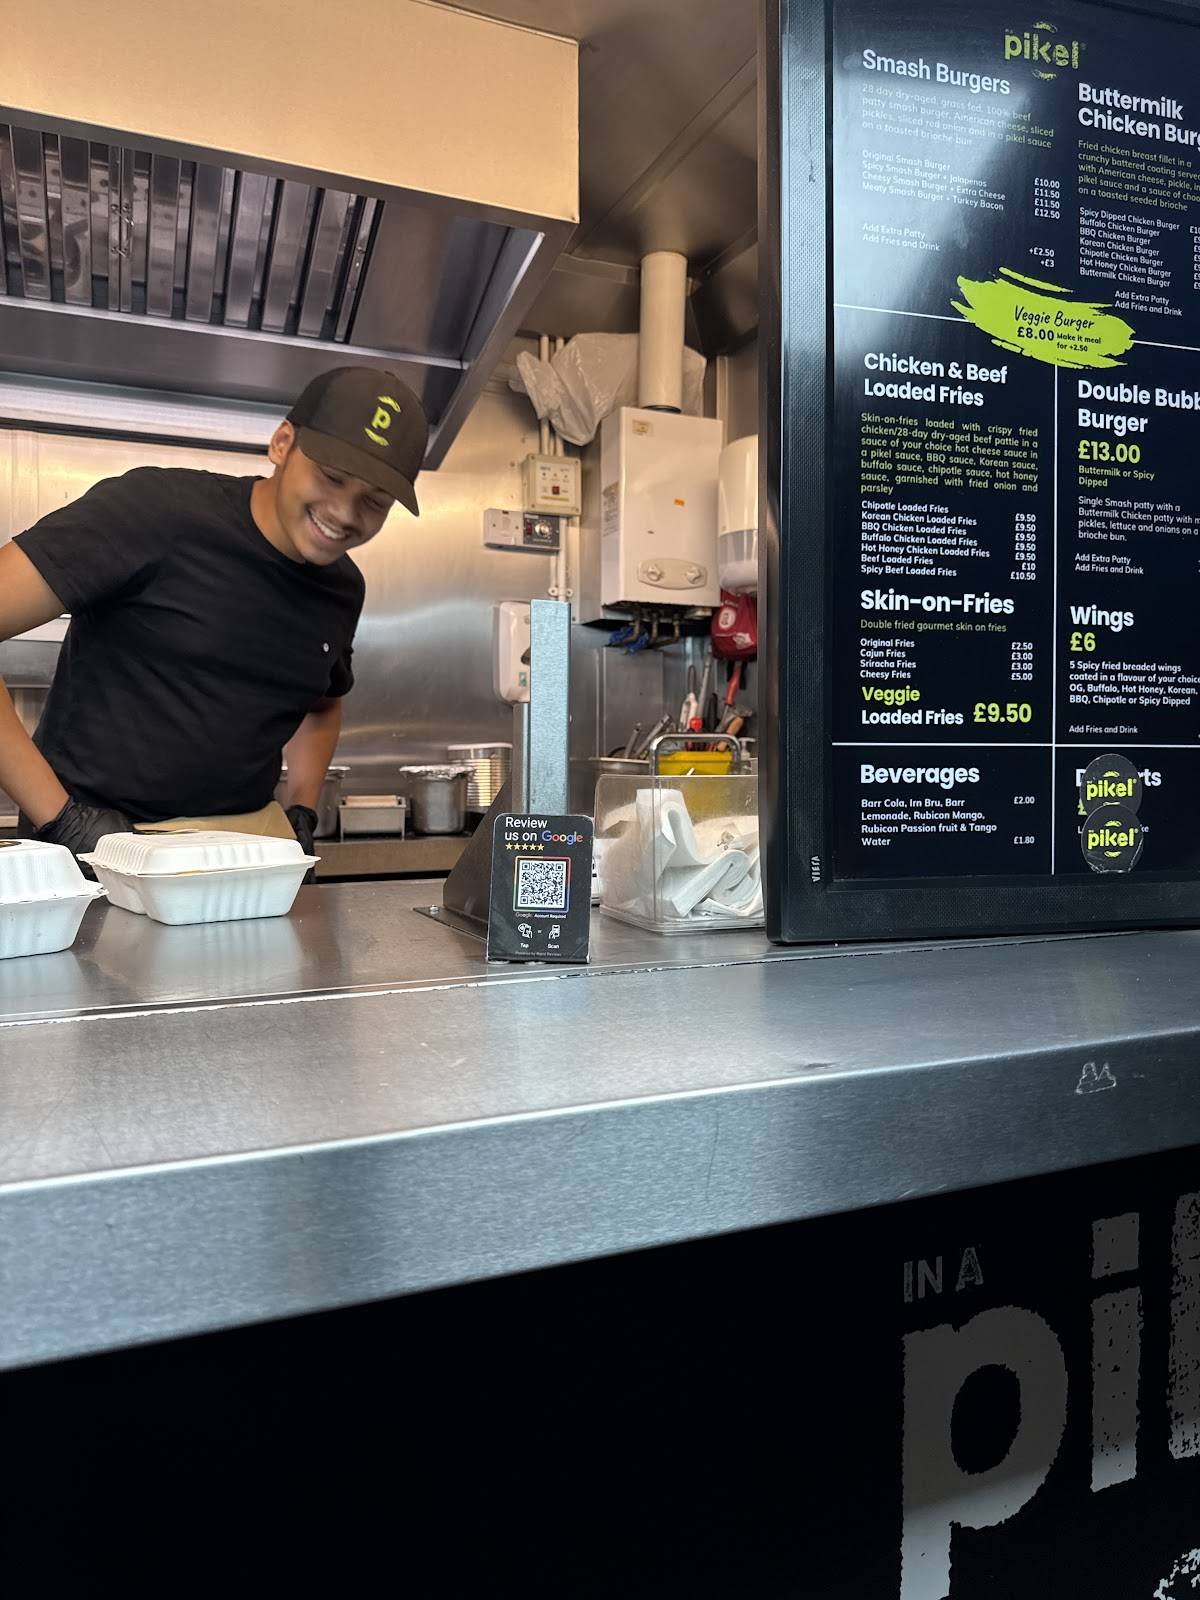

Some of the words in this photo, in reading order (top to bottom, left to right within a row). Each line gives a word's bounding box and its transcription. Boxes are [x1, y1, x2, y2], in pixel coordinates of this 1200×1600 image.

[1005, 32, 1078, 69] pikel
[863, 49, 930, 79] Smash
[936, 63, 1010, 94] Burgers
[1079, 83, 1183, 120] Buttermilk
[1078, 108, 1160, 139] Chicken
[1035, 178, 1060, 189] £10.00
[1035, 188, 1060, 198] £11.50
[1035, 198, 1060, 208] £11.50
[1098, 190, 1128, 201] toasted
[1130, 196, 1157, 205] seeded
[1160, 199, 1188, 210] brioche
[1035, 208, 1060, 219] £12.50
[1080, 208, 1099, 220] Spicy
[1101, 211, 1126, 222] Dipped
[1128, 215, 1155, 226] Chicken
[1157, 219, 1180, 231] Burger
[1080, 268, 1116, 279] Buttermilk
[1118, 273, 1145, 283] Chicken
[1147, 277, 1170, 288] Burger
[1015, 305, 1051, 326] Veggie
[1054, 310, 1094, 331] Burger
[1017, 327, 1054, 341] £8.00
[864, 352, 944, 378] Chicken
[948, 363, 962, 379] &
[967, 364, 1007, 384] Beef
[864, 379, 936, 402] Loaded
[940, 388, 984, 406] Fries
[1078, 380, 1150, 404] Double
[861, 414, 918, 426] Skin-on-fries
[926, 419, 954, 429] loaded
[962, 423, 980, 432] with
[988, 425, 1012, 437] crispy
[1019, 427, 1038, 437] fried
[1078, 408, 1148, 437] Burger
[1078, 440, 1140, 463] £13.00
[1079, 466, 1120, 476] Buttermilk
[1133, 470, 1154, 481] Spicy
[1079, 477, 1107, 488] Dipped
[862, 501, 895, 512] Chipotle
[898, 503, 927, 512] Loaded
[930, 504, 949, 513] Fries
[1079, 497, 1103, 507] Single
[1105, 499, 1132, 508] Smash
[1134, 502, 1154, 511] patty
[1015, 513, 1036, 522] £9.50
[1015, 523, 1036, 532] £9.50
[1015, 533, 1036, 542] £9.50
[861, 543, 876, 552] Hot
[879, 544, 904, 556] Honey
[907, 545, 938, 555] Chicken
[940, 547, 969, 556] Loaded
[971, 548, 990, 557] Fries
[1015, 543, 1036, 551] £9.50
[861, 554, 880, 562] Beef
[882, 555, 912, 563] Loaded
[914, 556, 933, 564] Fries
[1015, 553, 1036, 561] £9.50
[861, 565, 883, 576] Spicy
[885, 565, 904, 574] Beef
[906, 566, 935, 575] Loaded
[938, 568, 957, 576] Fries
[1022, 563, 1036, 571] £10
[1011, 572, 1036, 580] £10.50
[861, 588, 1014, 614] Skin-on-Fries
[1070, 604, 1134, 632] Wings
[861, 620, 892, 629] Double
[895, 620, 914, 629] fried
[917, 623, 953, 632] gourmet
[956, 622, 973, 631] skin
[988, 623, 1006, 632] fries
[860, 639, 893, 649] Original
[895, 639, 915, 647] Fries
[1011, 642, 1032, 650] £2.50
[1070, 632, 1096, 651] £6
[860, 649, 884, 659] Cajun
[886, 649, 905, 657] Fries
[860, 660, 894, 668] Sriracha
[897, 660, 916, 668] Fries
[1077, 661, 1100, 671] Spicy
[1102, 662, 1120, 670] fried
[1123, 663, 1156, 671] breaded
[1158, 664, 1181, 673] wings
[860, 670, 889, 680] Cheesy
[892, 670, 911, 678] Fries
[1069, 684, 1085, 692] OG,
[1087, 684, 1120, 693] Buffalo,
[862, 685, 920, 705] Veggie
[1070, 696, 1090, 704] BBQ,
[1093, 696, 1126, 705] Chipotle
[1139, 697, 1160, 706] Spicy
[1163, 697, 1190, 706] Dipped
[862, 710, 922, 724] Loaded
[926, 709, 963, 725] Fries
[974, 703, 1032, 722] £9.50
[861, 764, 980, 789] Beverages
[1087, 778, 1133, 800] pikel
[862, 799, 881, 807] Barr
[884, 799, 907, 808] Cola,
[910, 799, 922, 807] Irn
[925, 799, 943, 808] Bru,
[862, 812, 911, 821] Lemonade,
[914, 811, 949, 819] Rubicon
[952, 811, 985, 821] Mango,
[505, 817, 547, 828] Review
[862, 825, 898, 833] Rubicon
[901, 824, 936, 832] Passion
[939, 823, 958, 831] fruit
[960, 823, 966, 831] &
[969, 823, 997, 833] Tango
[505, 832, 519, 840] us
[523, 833, 537, 841] on
[542, 830, 583, 845] Google
[862, 838, 891, 846] Water
[1014, 836, 1035, 844] £1.80
[1088, 828, 1134, 849] pikel
[904, 1256, 943, 1302] IN
[956, 1247, 984, 1293] A
